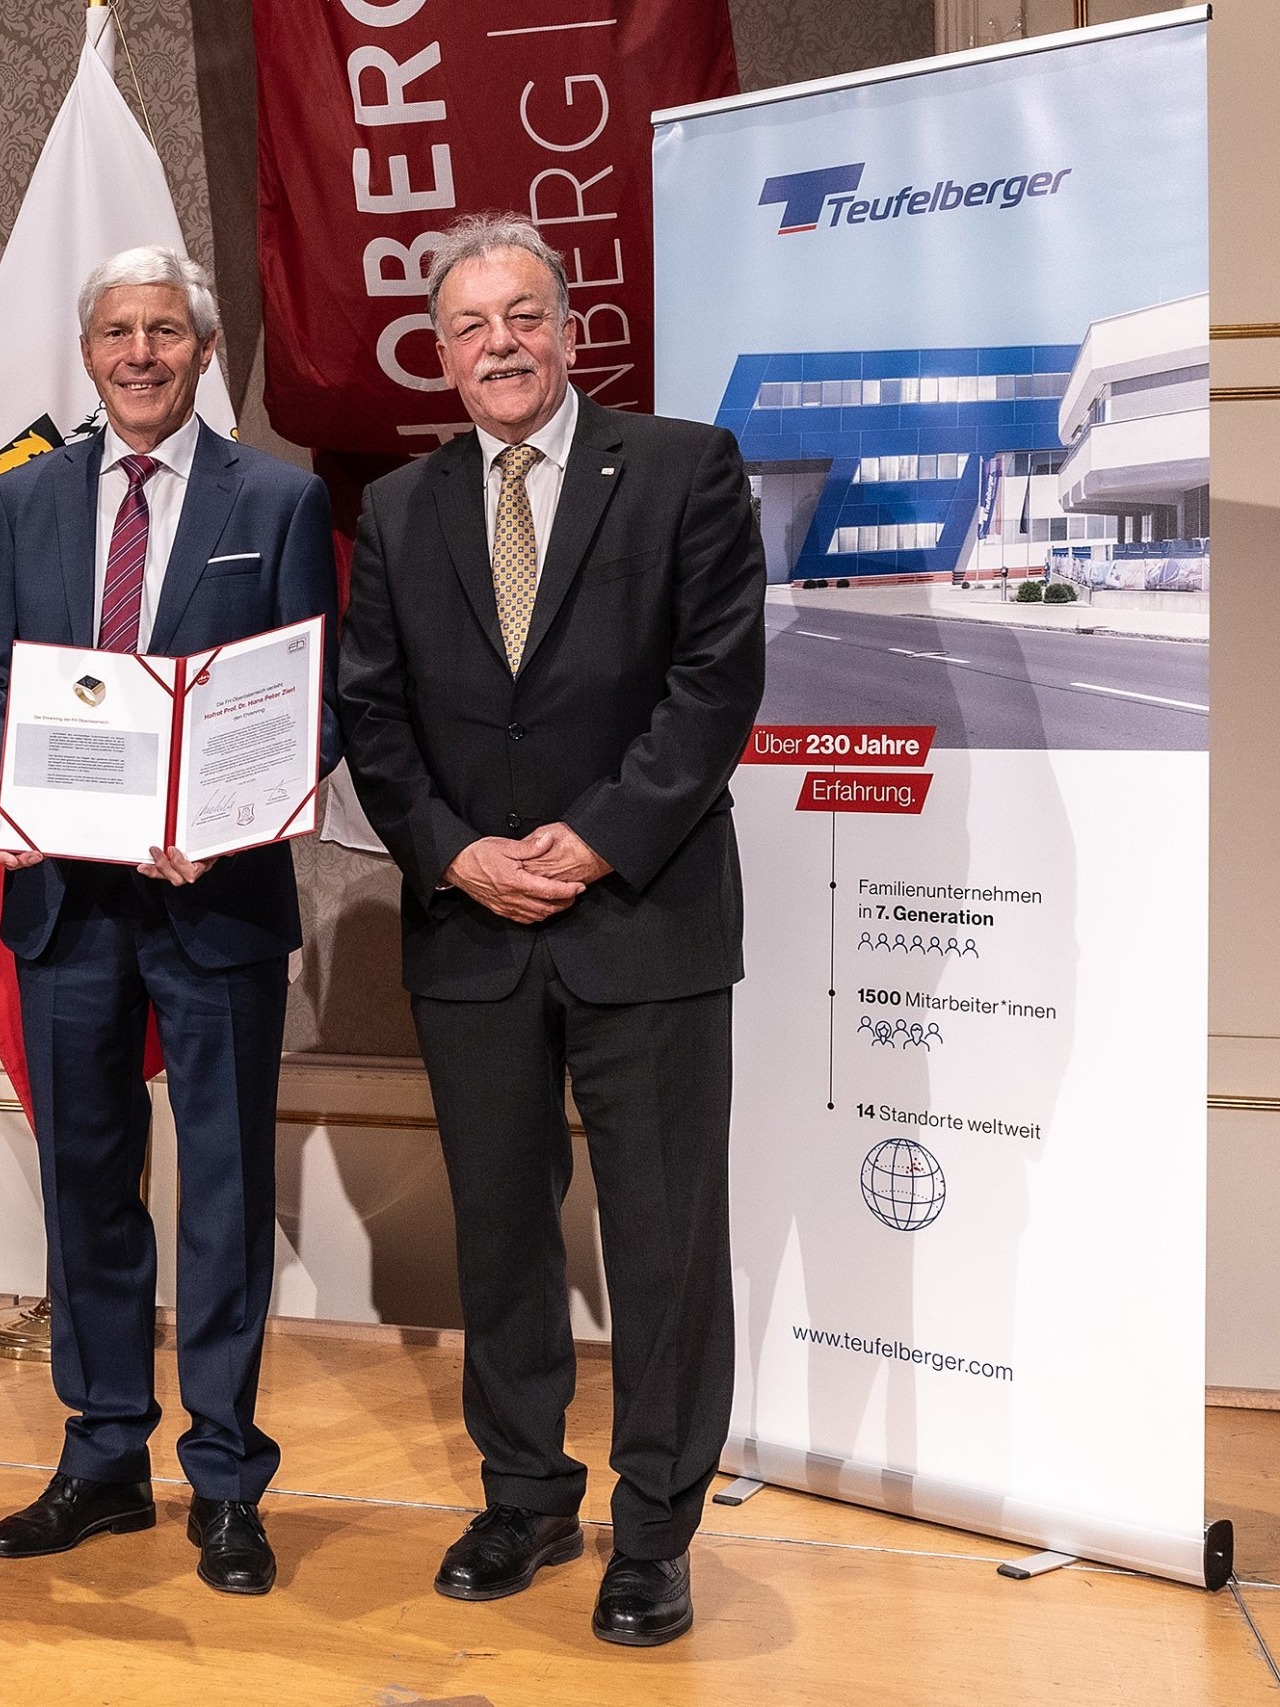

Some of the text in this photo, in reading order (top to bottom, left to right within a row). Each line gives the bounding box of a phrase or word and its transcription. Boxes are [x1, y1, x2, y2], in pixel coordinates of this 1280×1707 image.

[825, 166, 1073, 228] Teufelberger
[247, 698, 264, 707] Hans
[264, 692, 281, 701] Peter
[755, 730, 920, 756] Über 230 Jahre
[813, 779, 916, 807] Erfahrung.
[858, 878, 1042, 906] Familienunternehmen
[858, 902, 994, 927] in 7. Generation
[857, 987, 902, 1007] 1500
[856, 1102, 1042, 1140] 14 Standorte weltweit
[792, 1325, 1013, 1382] www.teufelberger.com
